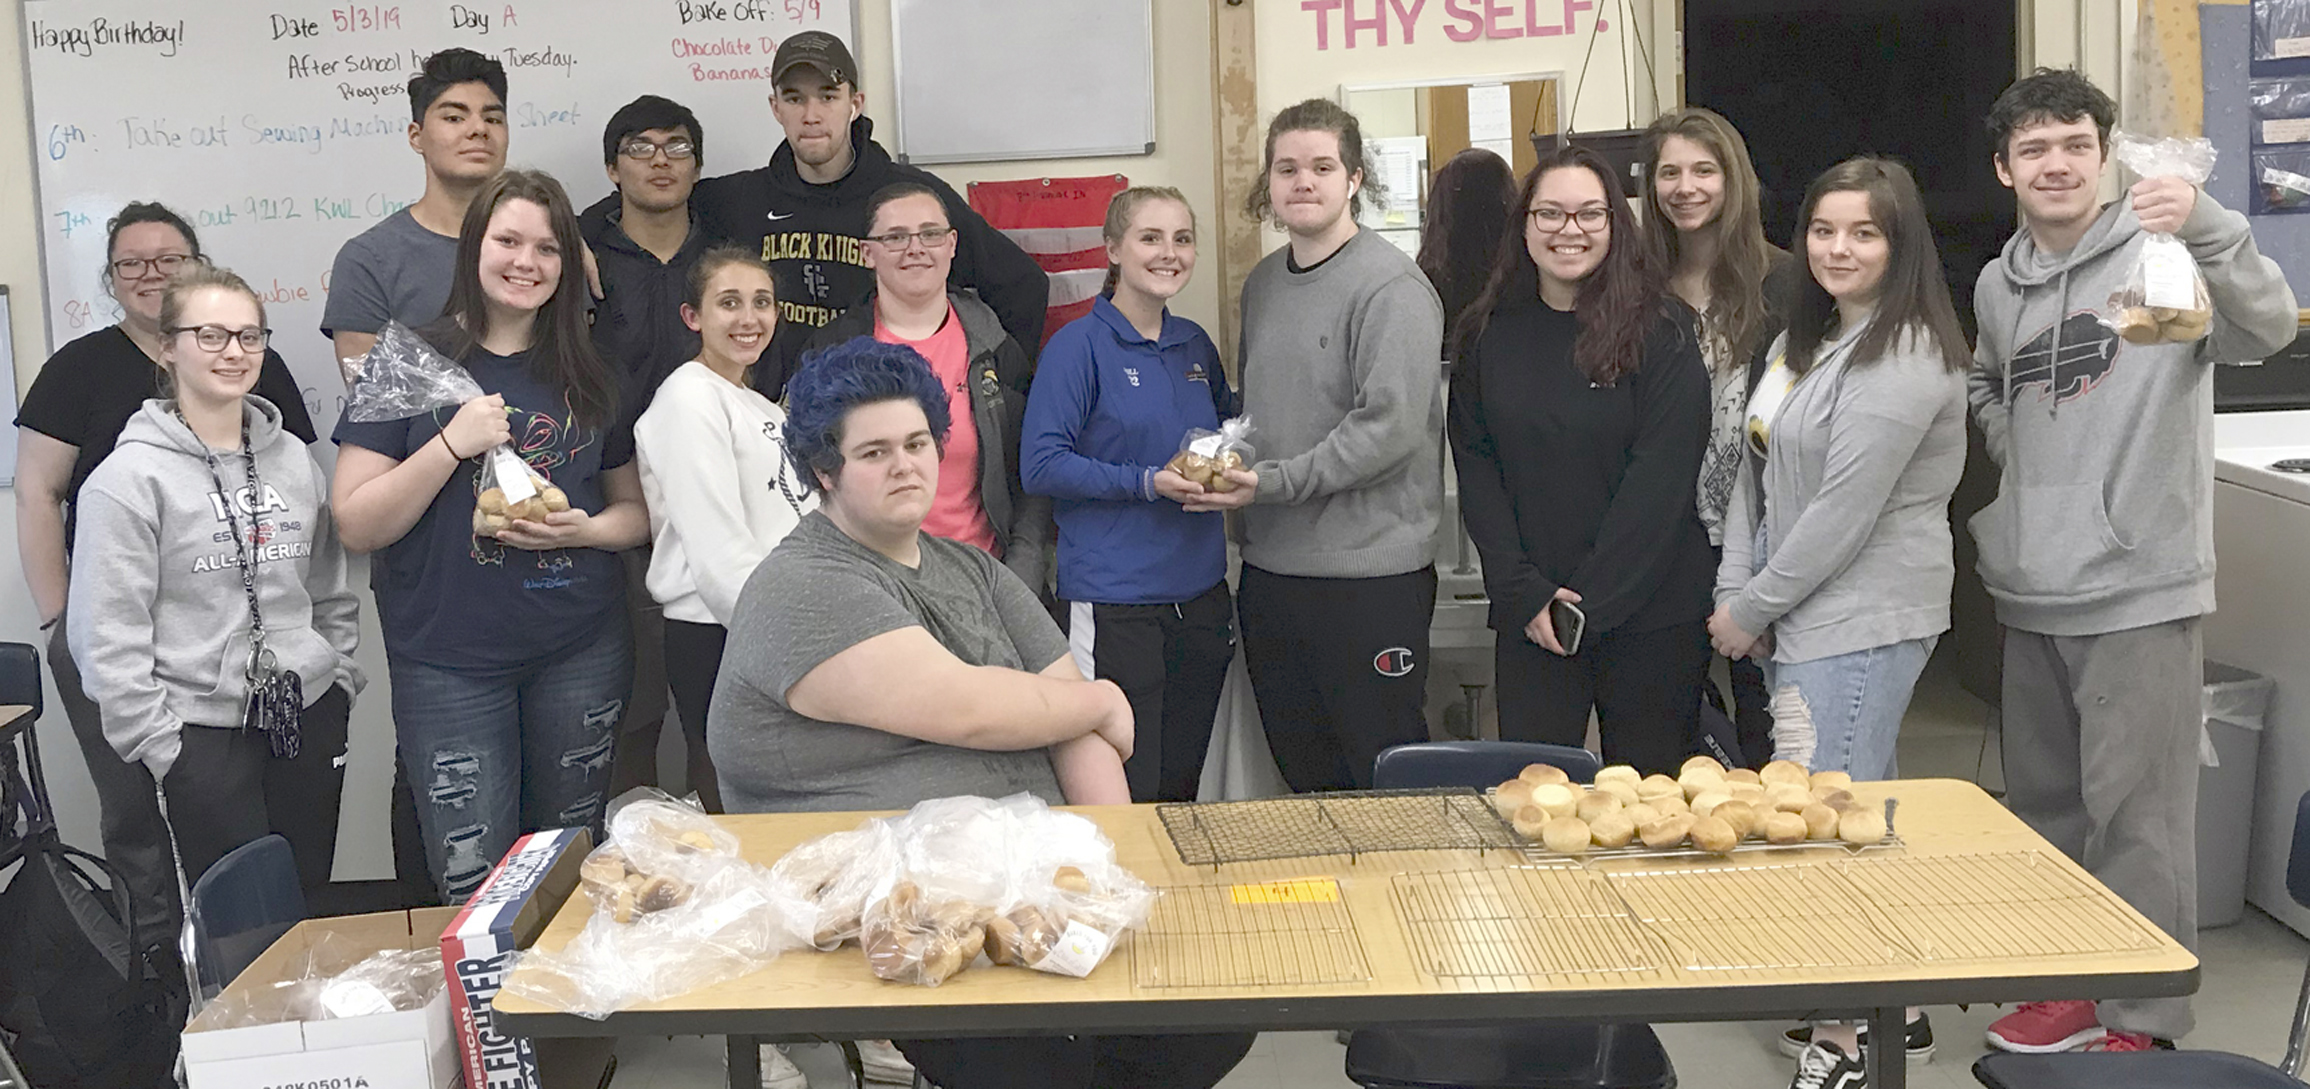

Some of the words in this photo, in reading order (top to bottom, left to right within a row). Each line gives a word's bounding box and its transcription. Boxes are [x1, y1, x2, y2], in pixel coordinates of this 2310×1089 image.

[270, 14, 319, 40] Date
[332, 5, 401, 32] 5/3/19
[450, 4, 489, 35] Day
[503, 5, 518, 28] A
[677, 0, 727, 25] Bake
[784, 0, 820, 25] 5/9
[1300, 0, 1425, 50] THY
[1443, 0, 1609, 42] SELF.
[32, 20, 92, 57] Happy
[93, 17, 184, 57] Birthday!
[671, 38, 752, 58] Chocolate
[288, 54, 340, 79] After
[346, 50, 402, 73] School
[503, 47, 578, 78] Tuesday.
[688, 63, 772, 82] Bananas
[336, 83, 406, 105] Progress
[117, 116, 181, 149] Take
[190, 115, 228, 147] out
[241, 113, 322, 155] Sewing
[330, 115, 410, 139] Machin
[517, 101, 581, 128] Sheet
[199, 204, 238, 228] out
[314, 198, 361, 221] KWL
[761, 232, 812, 261] BLACK
